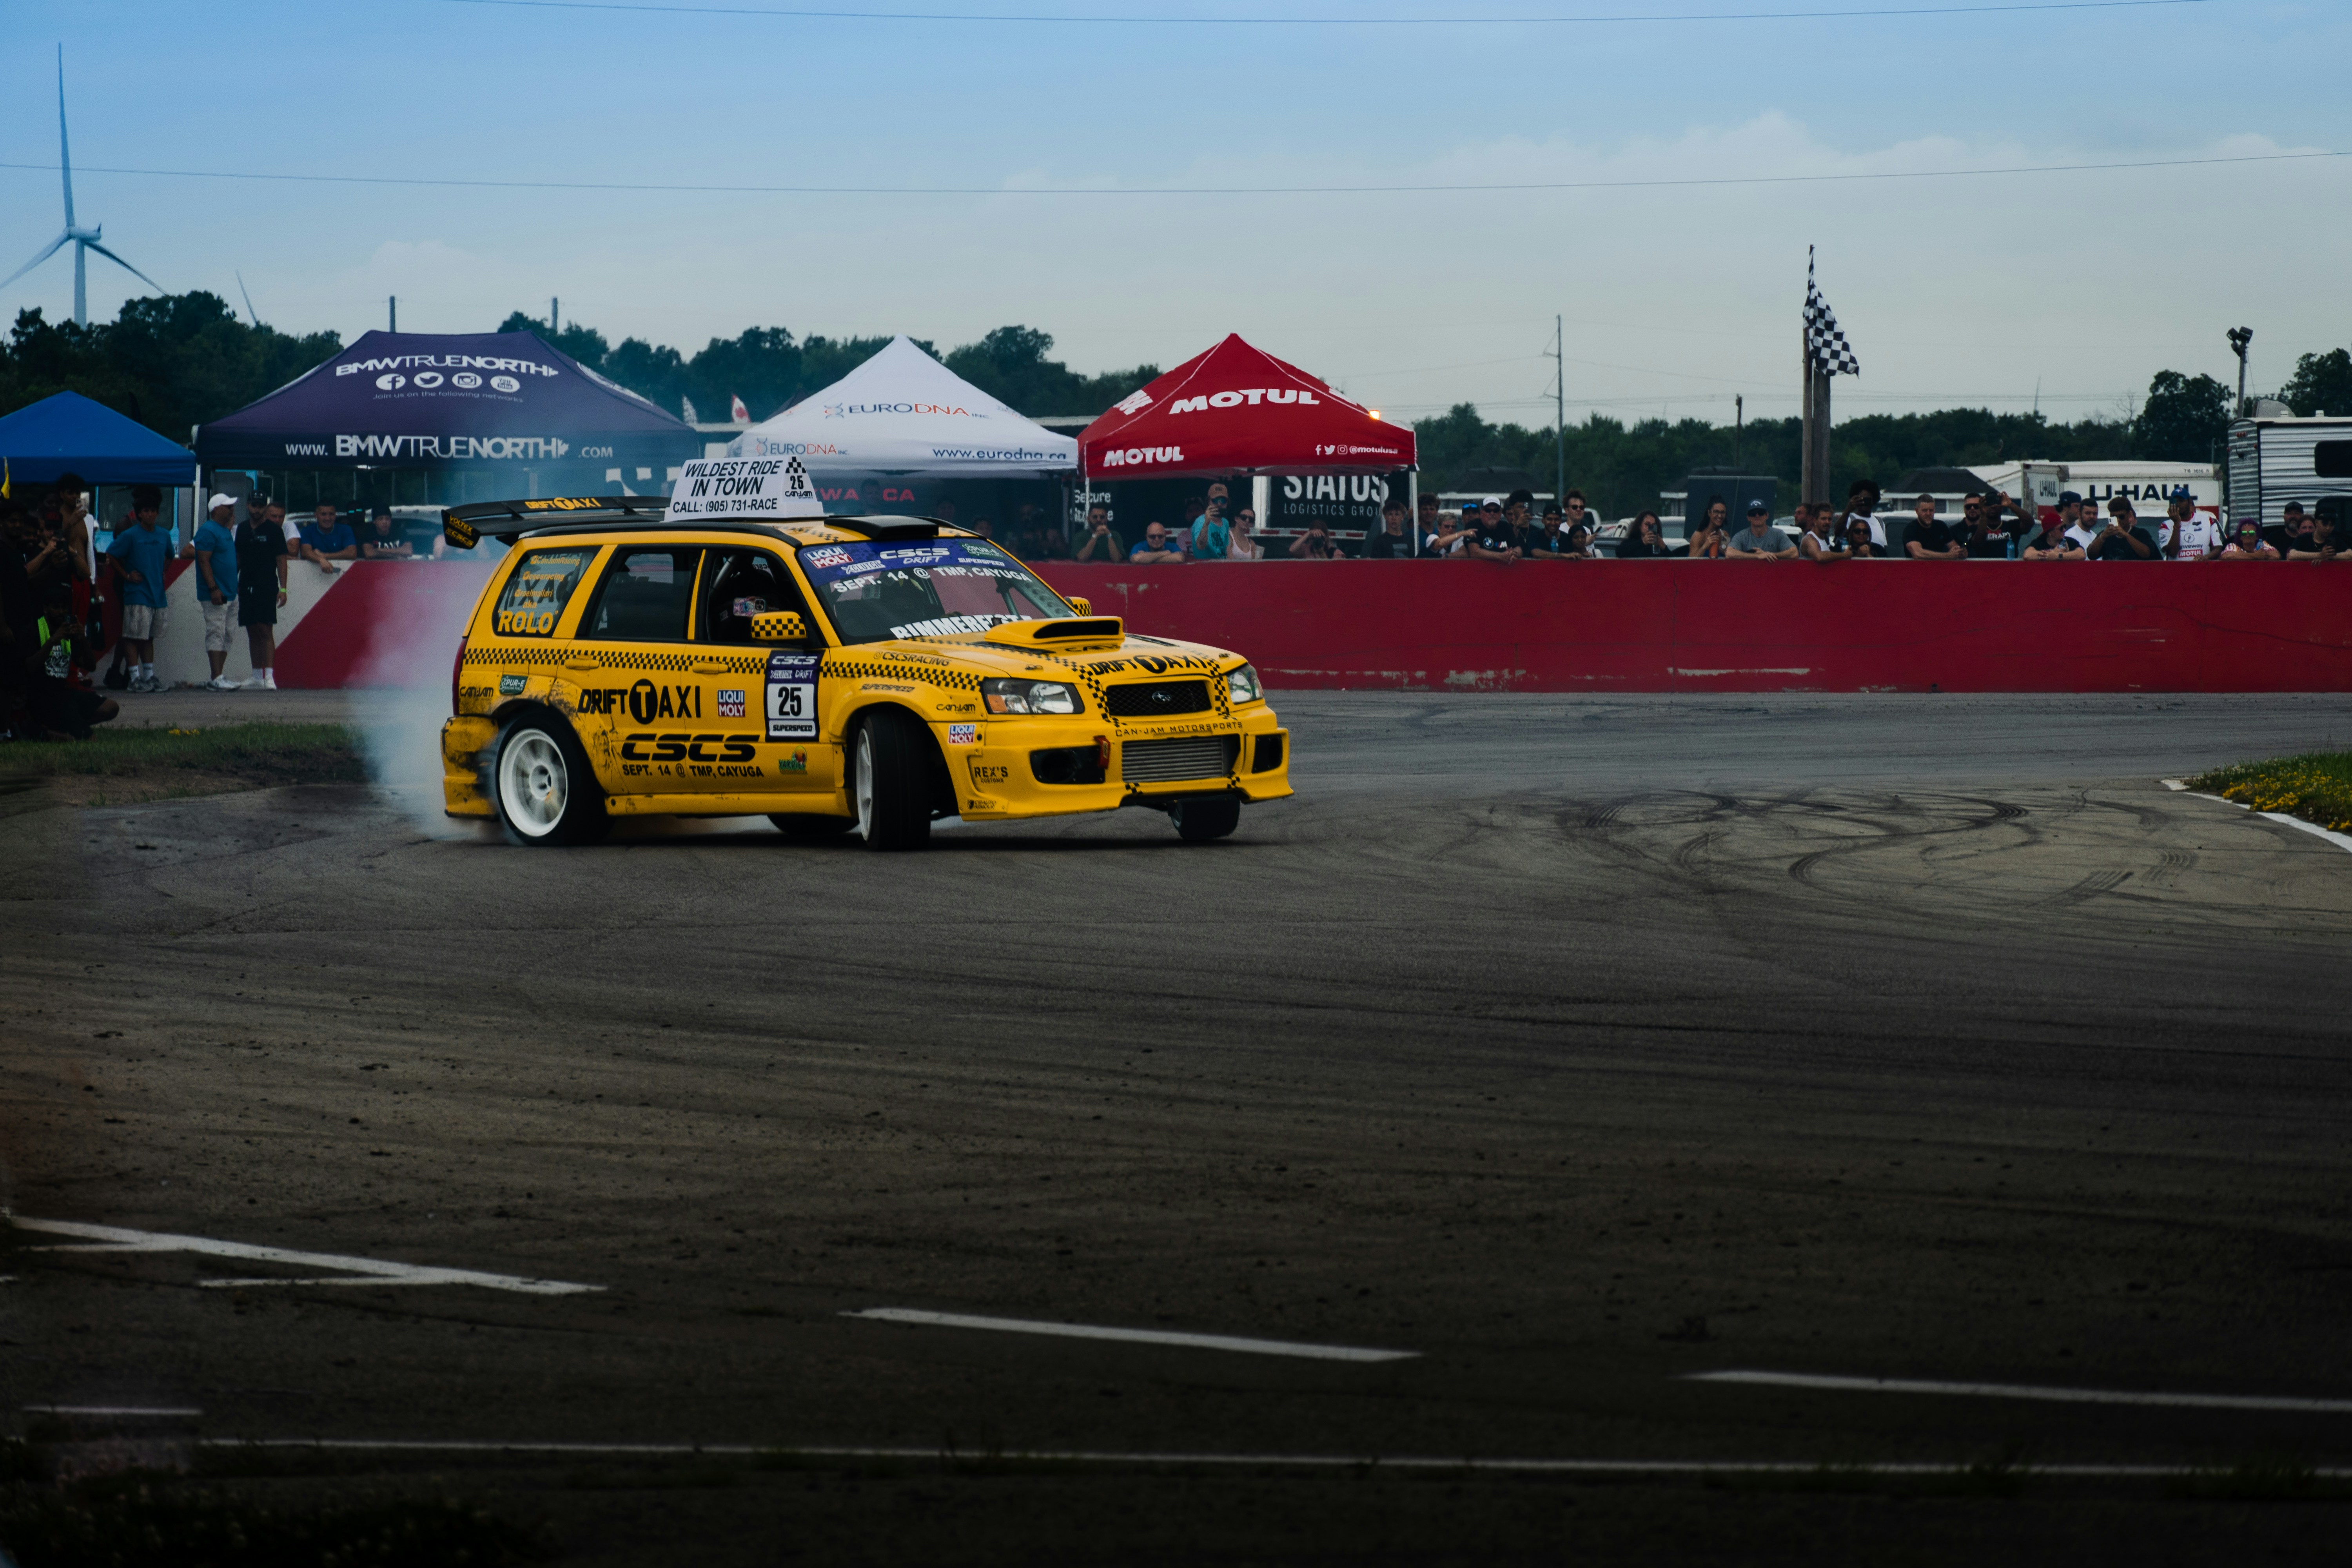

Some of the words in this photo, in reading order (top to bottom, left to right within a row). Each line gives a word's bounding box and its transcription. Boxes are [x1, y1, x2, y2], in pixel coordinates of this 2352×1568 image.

[482, 394, 523, 403] networks
[1169, 389, 1320, 414] MOTUL
[849, 402, 969, 416] EURODNA
[285, 444, 328, 456] www.
[770, 443, 837, 455] EURODNA
[1349, 446, 1398, 454] @motulusa
[1103, 446, 1184, 467] MOTUL
[685, 461, 748, 477] WILDEST
[747, 460, 783, 475] RIDE
[690, 479, 711, 497] IN
[714, 476, 764, 496] TOWN
[790, 475, 804, 490] 25
[525, 500, 557, 509] DRIFT
[673, 502, 702, 513] CALL:
[706, 500, 728, 512] (905)
[731, 498, 777, 511] 731-RACE
[1284, 503, 1345, 516] LOGISTICS
[1351, 506, 1382, 517] GROU
[450, 514, 473, 533] VOLTEX
[806, 547, 845, 561] LIQUI
[815, 553, 850, 568] MOLY
[880, 548, 950, 559] CSCS
[903, 555, 943, 564] DRIFT
[841, 560, 886, 574] XCLUTCH
[957, 557, 1005, 567] SUPERSPEED
[833, 575, 882, 593] SEPT.
[887, 570, 909, 581] 14
[913, 568, 931, 579] @
[932, 566, 972, 577] TMP,
[975, 567, 1033, 583] CAYUGA
[522, 600, 537, 608] aka
[771, 656, 818, 665] CSCS
[1087, 659, 1138, 676] DRIFT
[1136, 655, 1208, 673] TAXI
[795, 670, 813, 679] DRIFT
[505, 679, 526, 688] PUR-E
[860, 684, 915, 693] SUPERSPEED
[577, 688, 628, 715] DRIFT
[634, 684, 701, 719] TAXI
[718, 690, 744, 704] LIQUI
[778, 686, 802, 717] 25
[719, 704, 745, 717] MOLY
[773, 724, 813, 732] SUPERSPEED
[950, 725, 975, 734] LIQUI
[1115, 726, 1165, 737] CAN-JAM
[1169, 721, 1243, 735] MOTORSPORTS
[950, 734, 973, 743] MOLY
[621, 733, 760, 762] CSCS
[622, 764, 653, 777] SEPT.
[657, 764, 671, 777] 14
[675, 763, 686, 778] @
[689, 765, 717, 779] TMP,
[717, 765, 764, 778] CAYUGA
[974, 766, 1008, 778] REX'S
